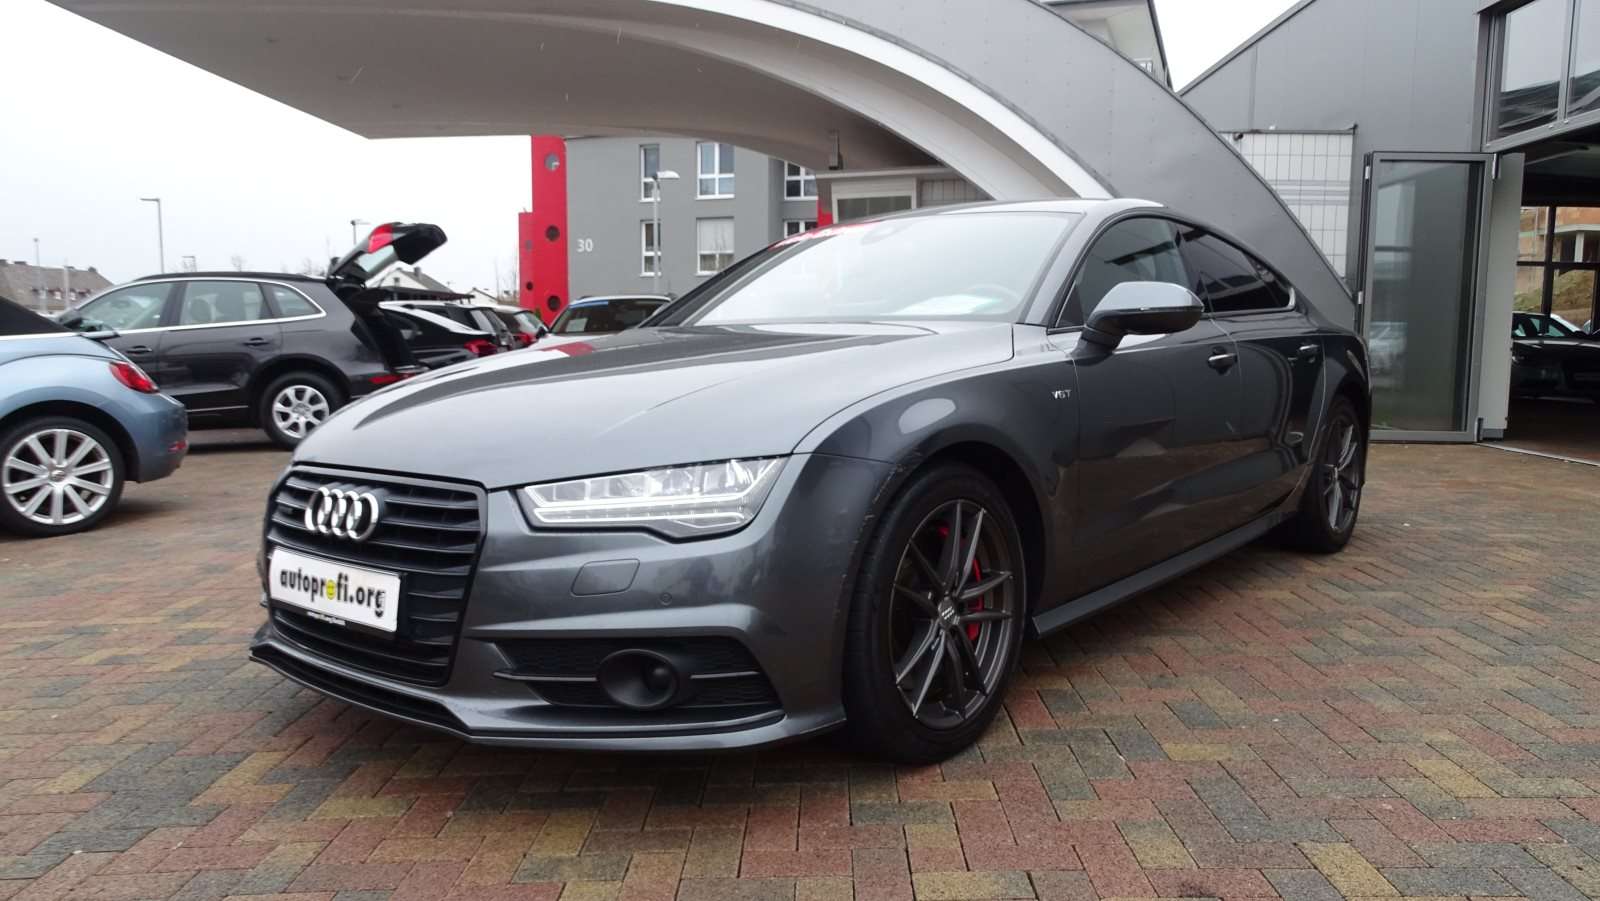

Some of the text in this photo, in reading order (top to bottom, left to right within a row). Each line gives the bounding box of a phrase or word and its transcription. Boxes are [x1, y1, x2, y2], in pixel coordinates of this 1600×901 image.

[577, 238, 593, 252] 30
[1051, 389, 1071, 399] V6T
[280, 568, 385, 618] autoprofi.org
